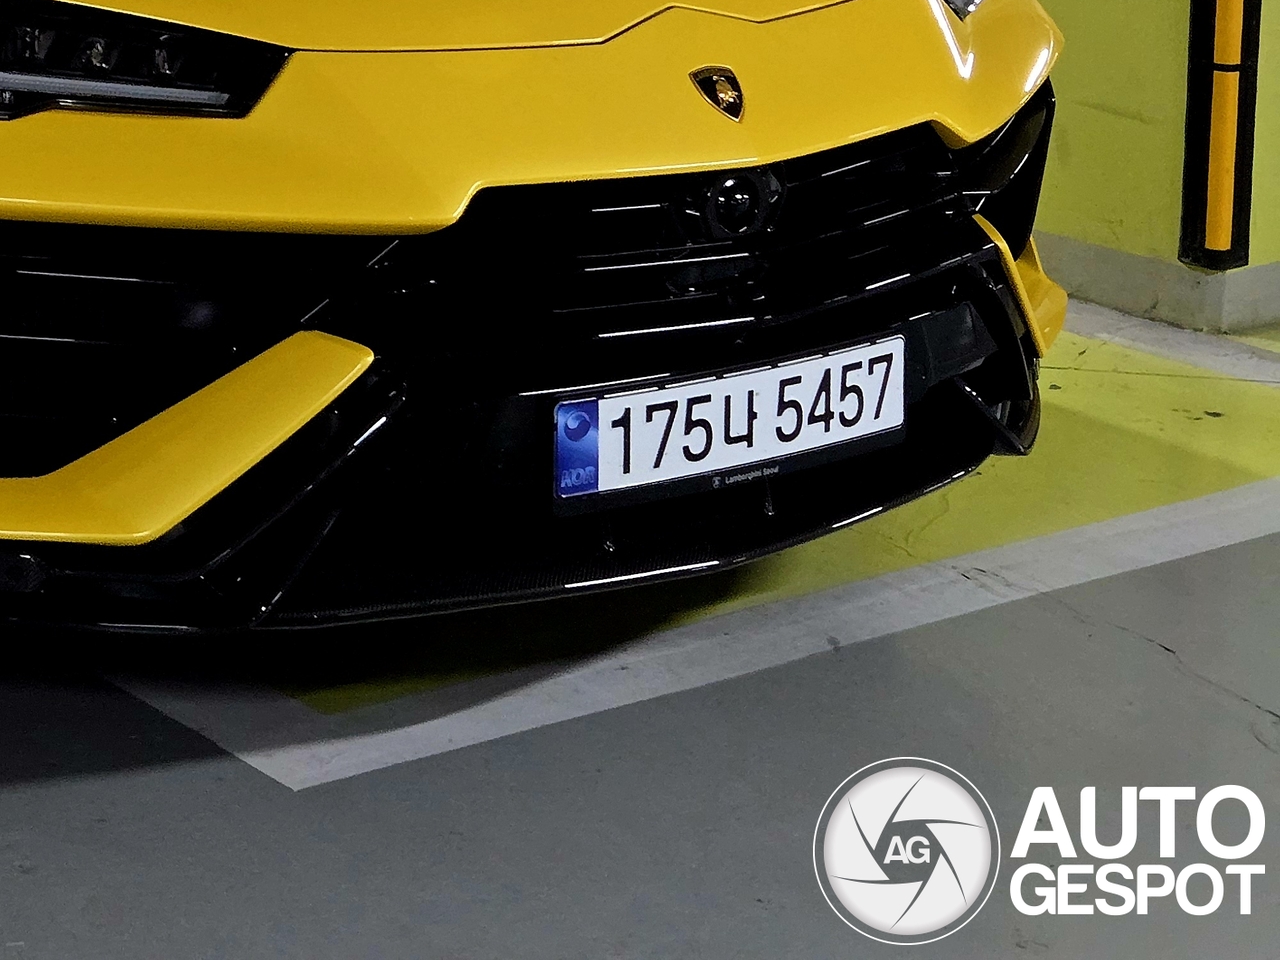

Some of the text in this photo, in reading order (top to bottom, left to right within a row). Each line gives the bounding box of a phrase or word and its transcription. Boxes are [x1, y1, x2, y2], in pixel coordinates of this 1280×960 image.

[611, 352, 894, 475] 175나 5457
[561, 466, 596, 488] KOR
